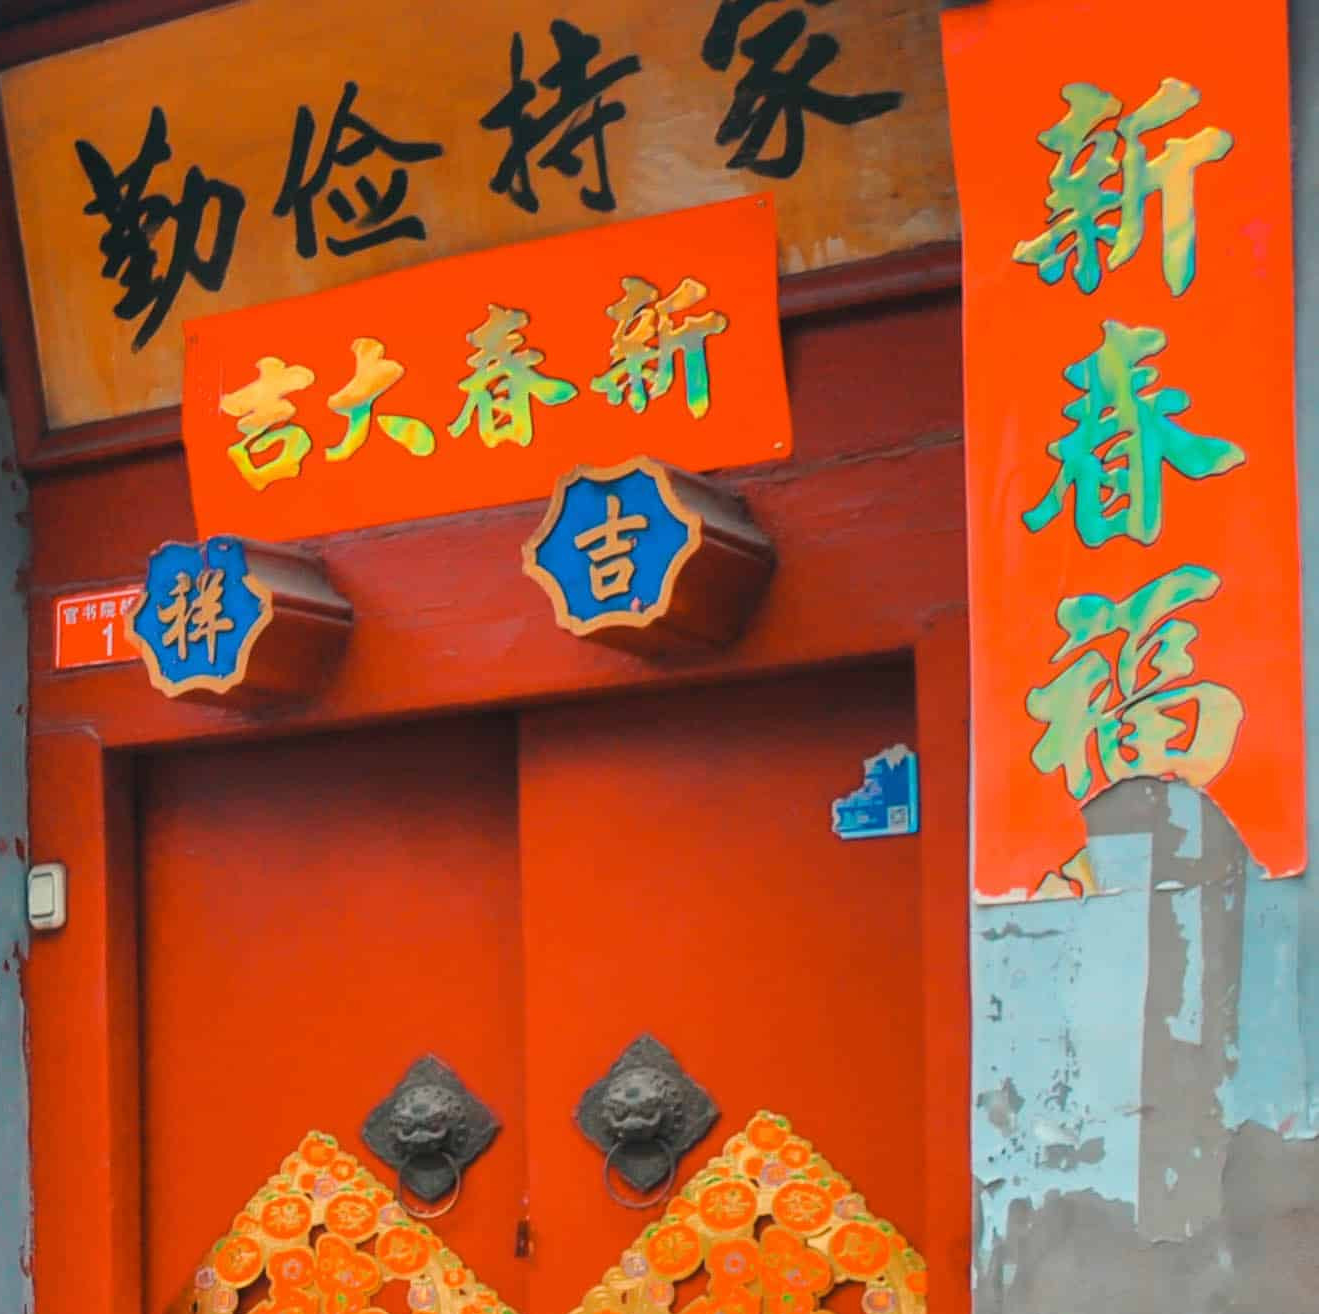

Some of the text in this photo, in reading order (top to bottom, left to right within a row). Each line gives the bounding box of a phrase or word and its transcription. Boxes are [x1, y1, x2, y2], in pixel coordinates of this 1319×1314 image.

[75, 0, 903, 352] 勤俭持家
[221, 277, 729, 492] 新春大吉
[1012, 77, 1246, 898] 新春福
[156, 573, 236, 665] 祥
[574, 494, 661, 603] 吉
